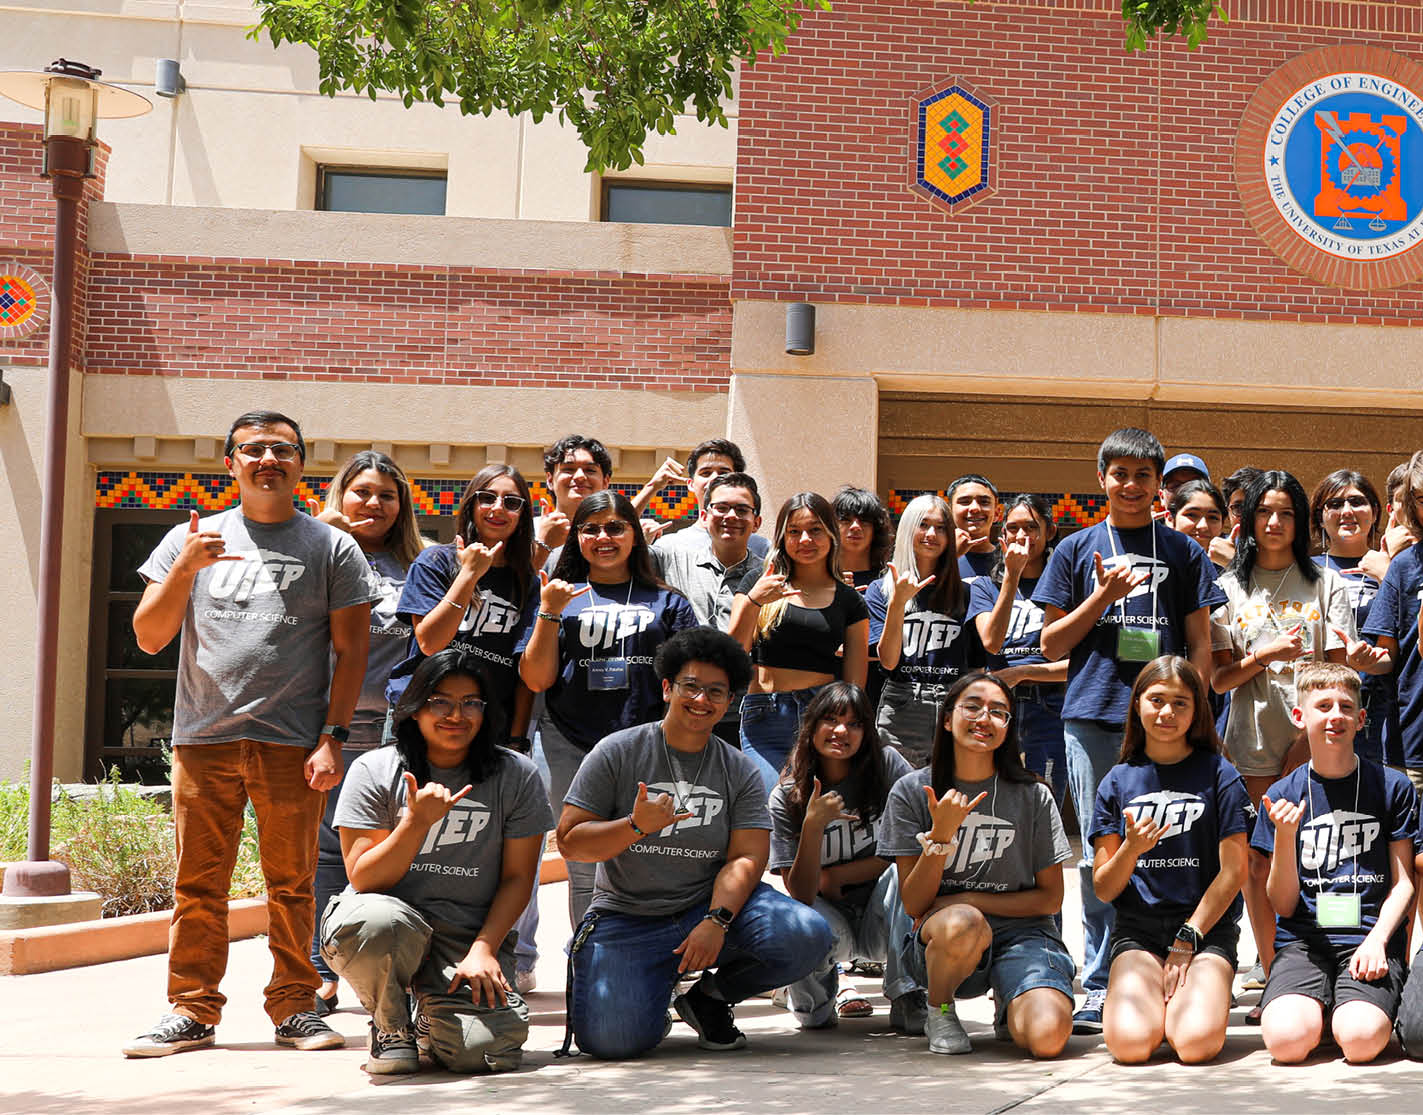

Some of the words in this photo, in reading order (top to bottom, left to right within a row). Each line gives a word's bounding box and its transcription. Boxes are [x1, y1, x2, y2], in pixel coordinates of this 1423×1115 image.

[1270, 83, 1327, 146] COLLEGE
[1330, 76, 1353, 91] OF
[1270, 175, 1285, 200] THE
[1282, 200, 1345, 252] UNIVERSITY
[1347, 244, 1364, 256] OF
[1367, 238, 1407, 256] TEXAS
[1407, 226, 1423, 242] AT
[208, 548, 306, 603] UTEP
[1092, 552, 1170, 607] TEP
[204, 608, 258, 621] COMPUTER
[258, 612, 299, 626] SCIENCE
[383, 625, 413, 638] SCIENC
[577, 603, 657, 650] UTEP
[1136, 615, 1169, 626] SCIENCE
[902, 610, 962, 659] UTEP
[483, 650, 514, 668] SCIENCE
[646, 780, 724, 839] TEP
[629, 843, 683, 857] COMPUTER
[683, 848, 720, 859] SCIENCE
[1300, 809, 1381, 872] UTEP
[410, 862, 441, 874] PUTER
[441, 866, 480, 877] SCIENCE
[1137, 858, 1167, 869] PUTER
[1167, 857, 1200, 868] SCIENC
[1351, 874, 1385, 885] SCIENCE
